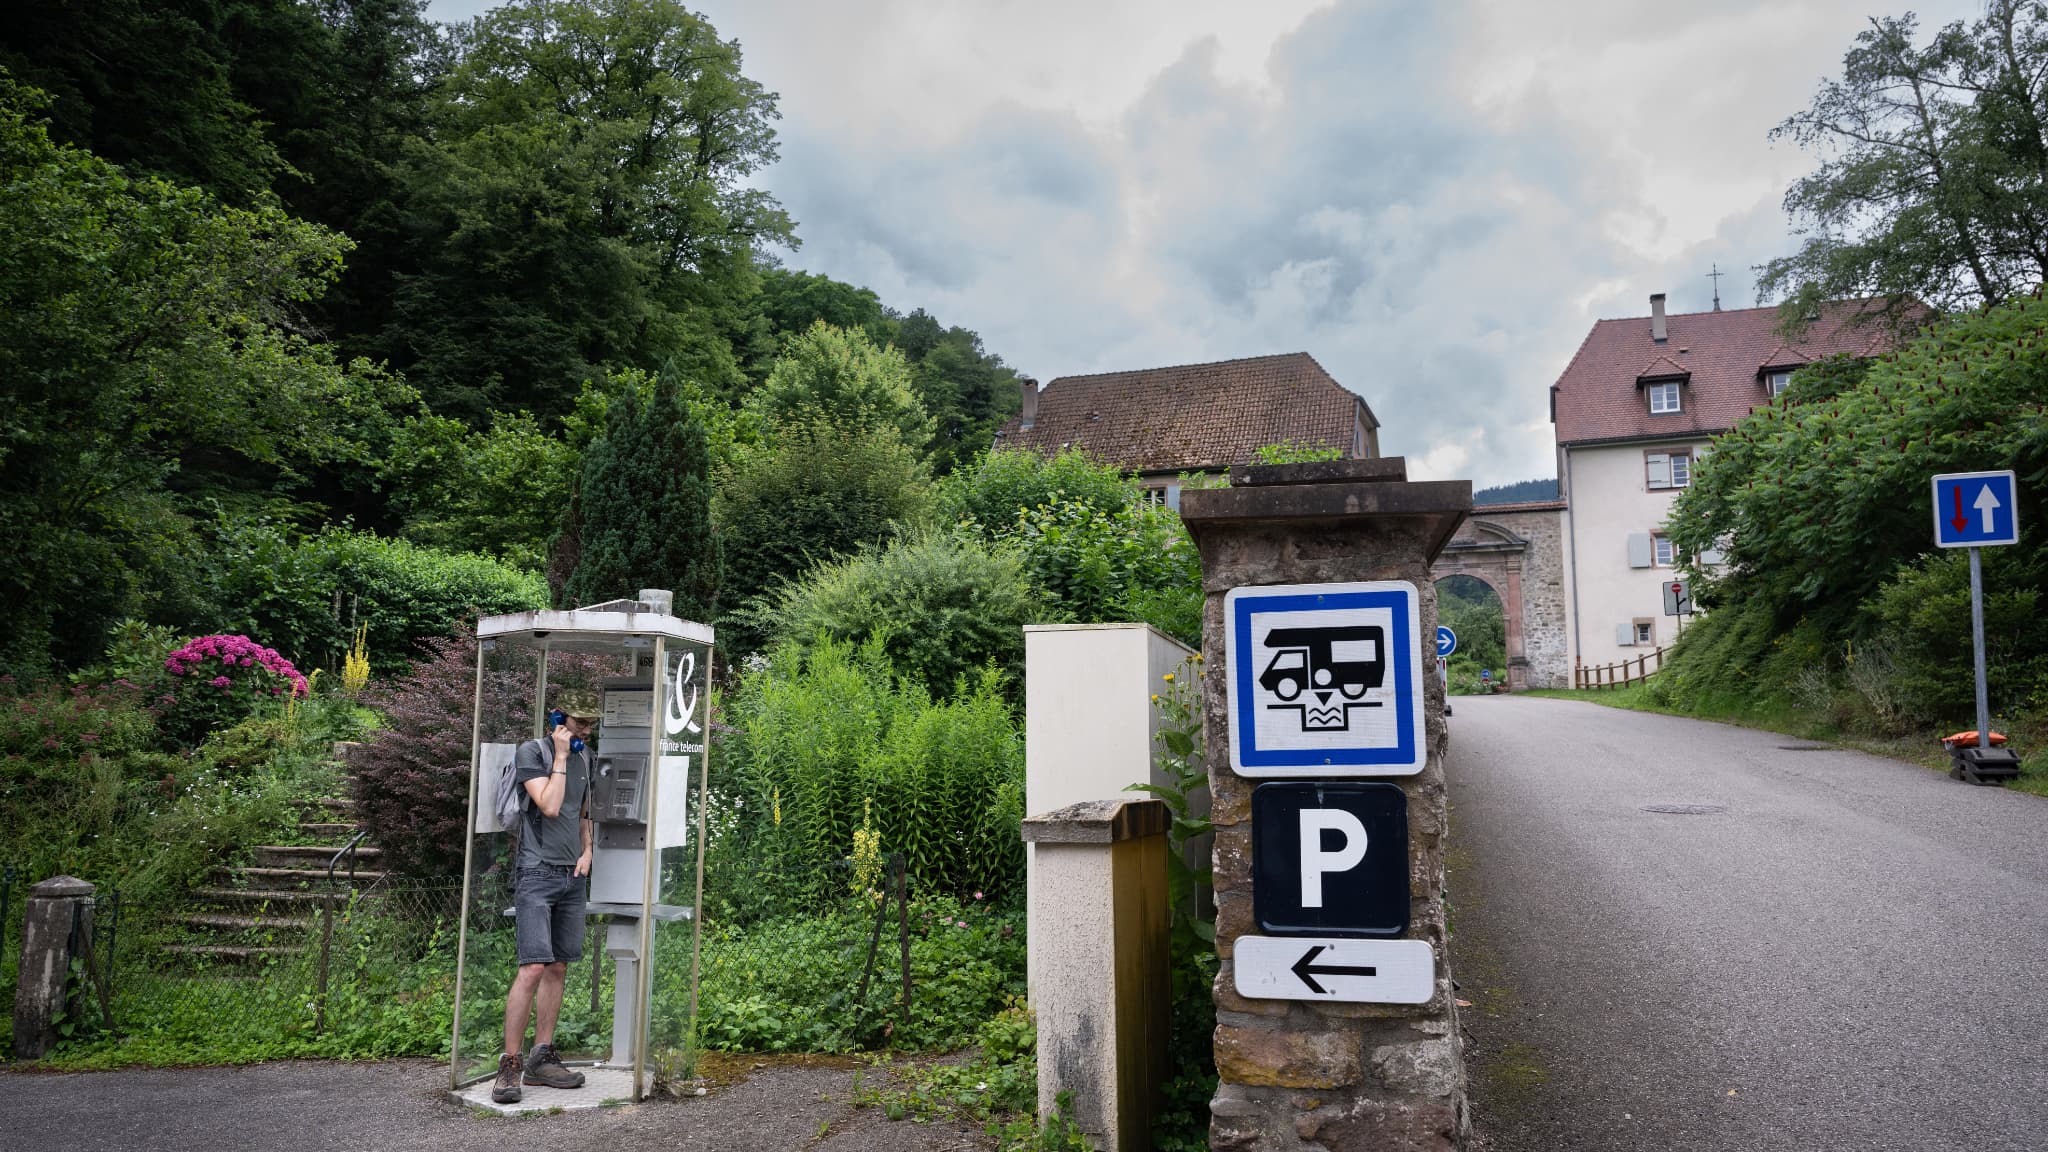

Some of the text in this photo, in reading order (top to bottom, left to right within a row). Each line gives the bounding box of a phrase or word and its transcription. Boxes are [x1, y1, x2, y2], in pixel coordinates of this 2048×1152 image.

[660, 738, 704, 753] france telecom
[1300, 808, 1368, 907] P
